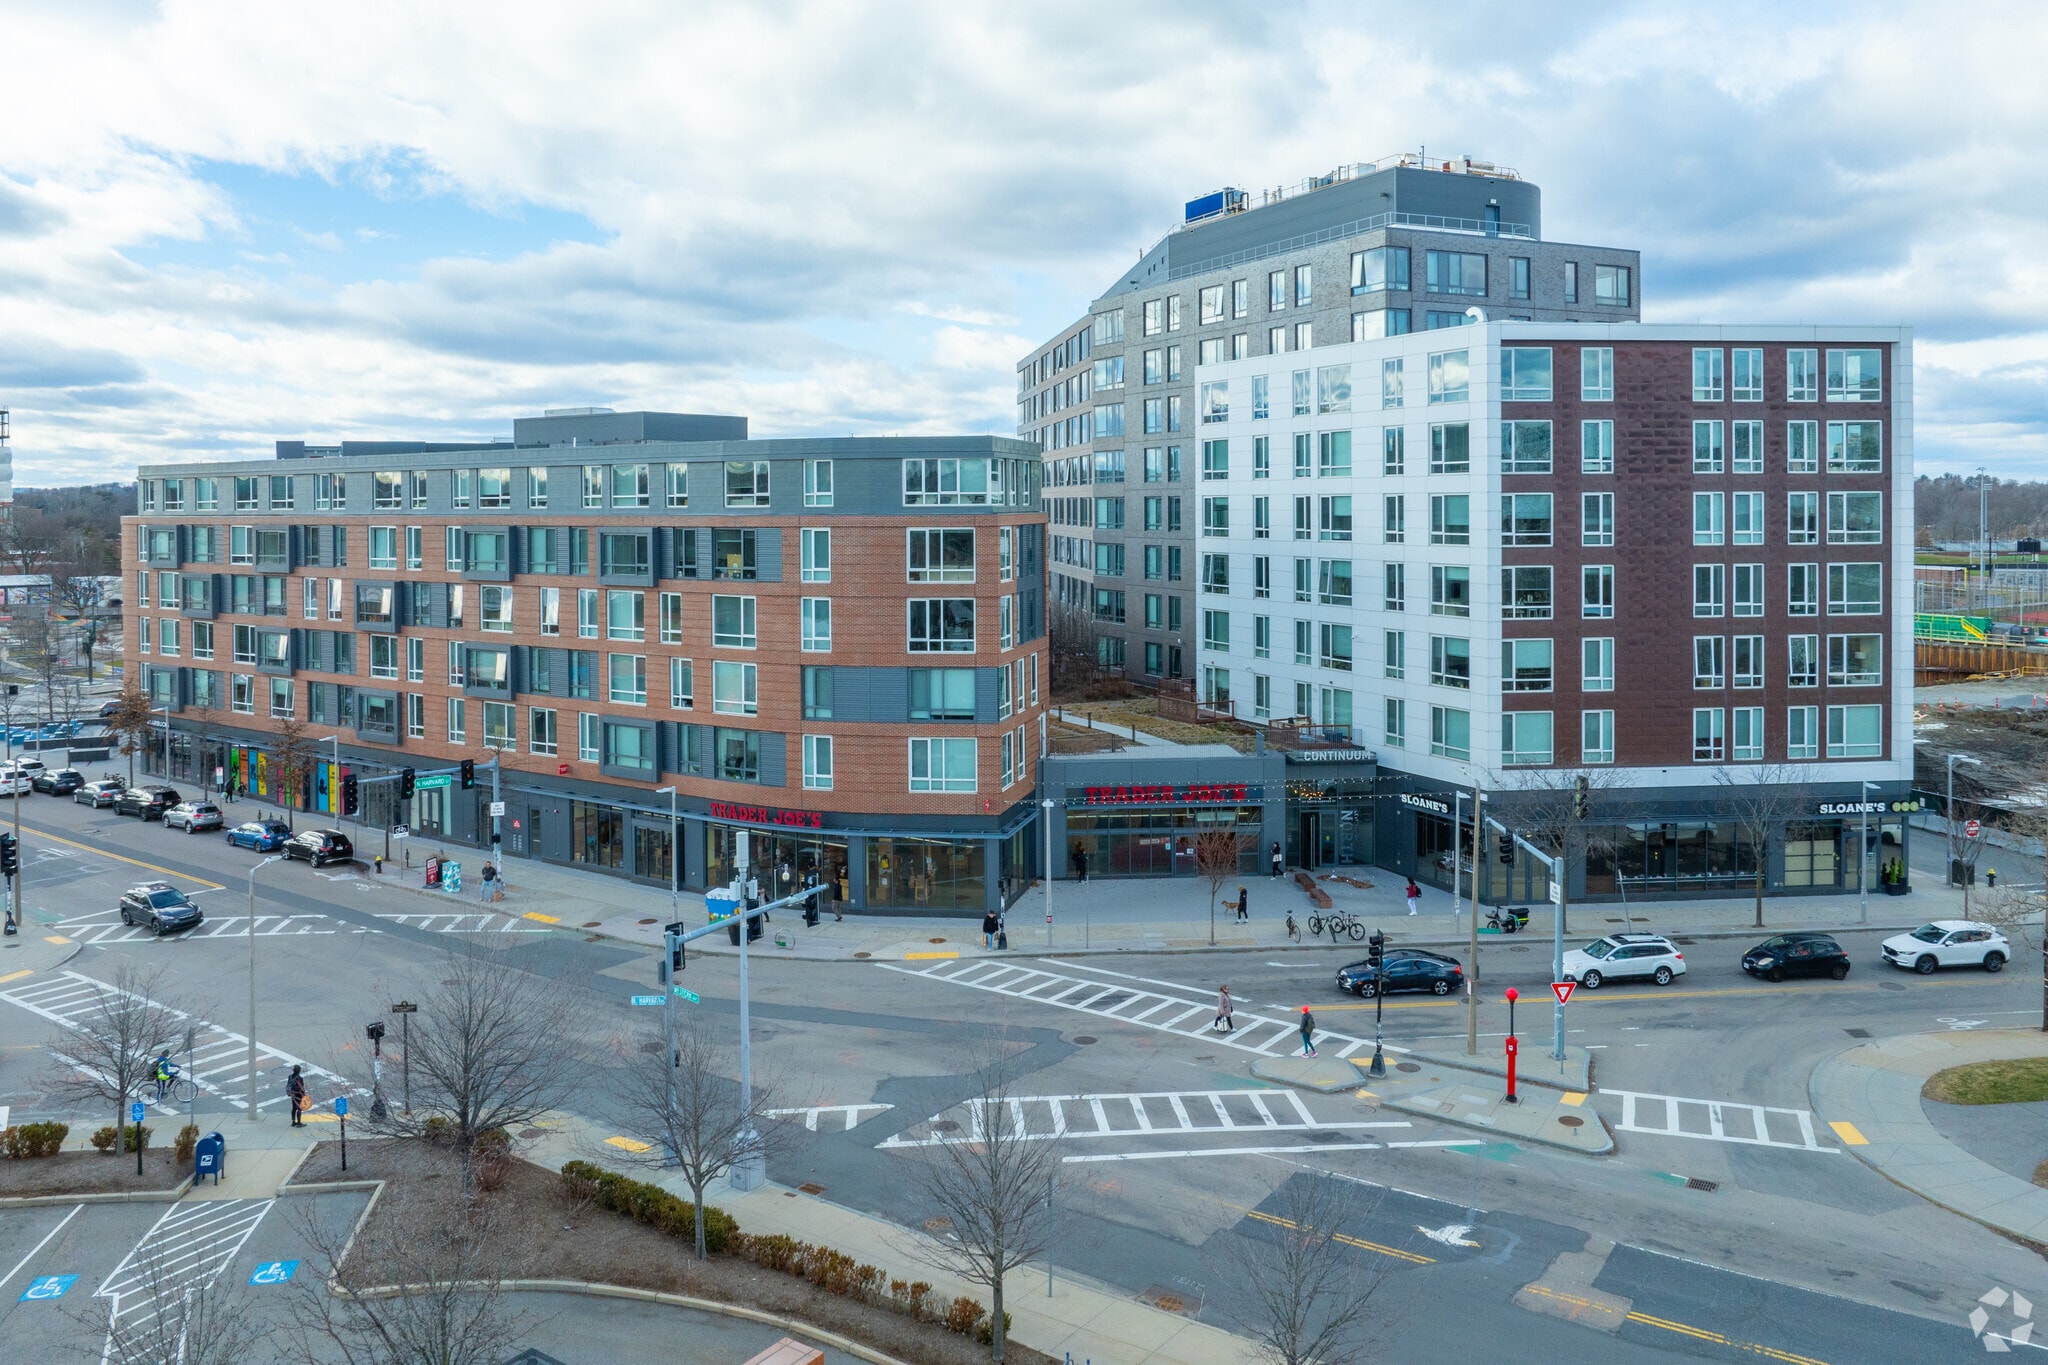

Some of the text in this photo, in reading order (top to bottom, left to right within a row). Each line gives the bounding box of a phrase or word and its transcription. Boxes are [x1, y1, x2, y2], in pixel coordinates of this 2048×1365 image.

[1304, 751, 1371, 761] CONTINUUM
[421, 778, 445, 786] HARVARD
[1085, 783, 1248, 805] TRADER JOE'S
[1401, 794, 1448, 814] SLOANE'S
[710, 802, 822, 829] TRADER JOE'S
[1819, 802, 1886, 814] SLOANE'S
[1341, 810, 1354, 864] NORTH
